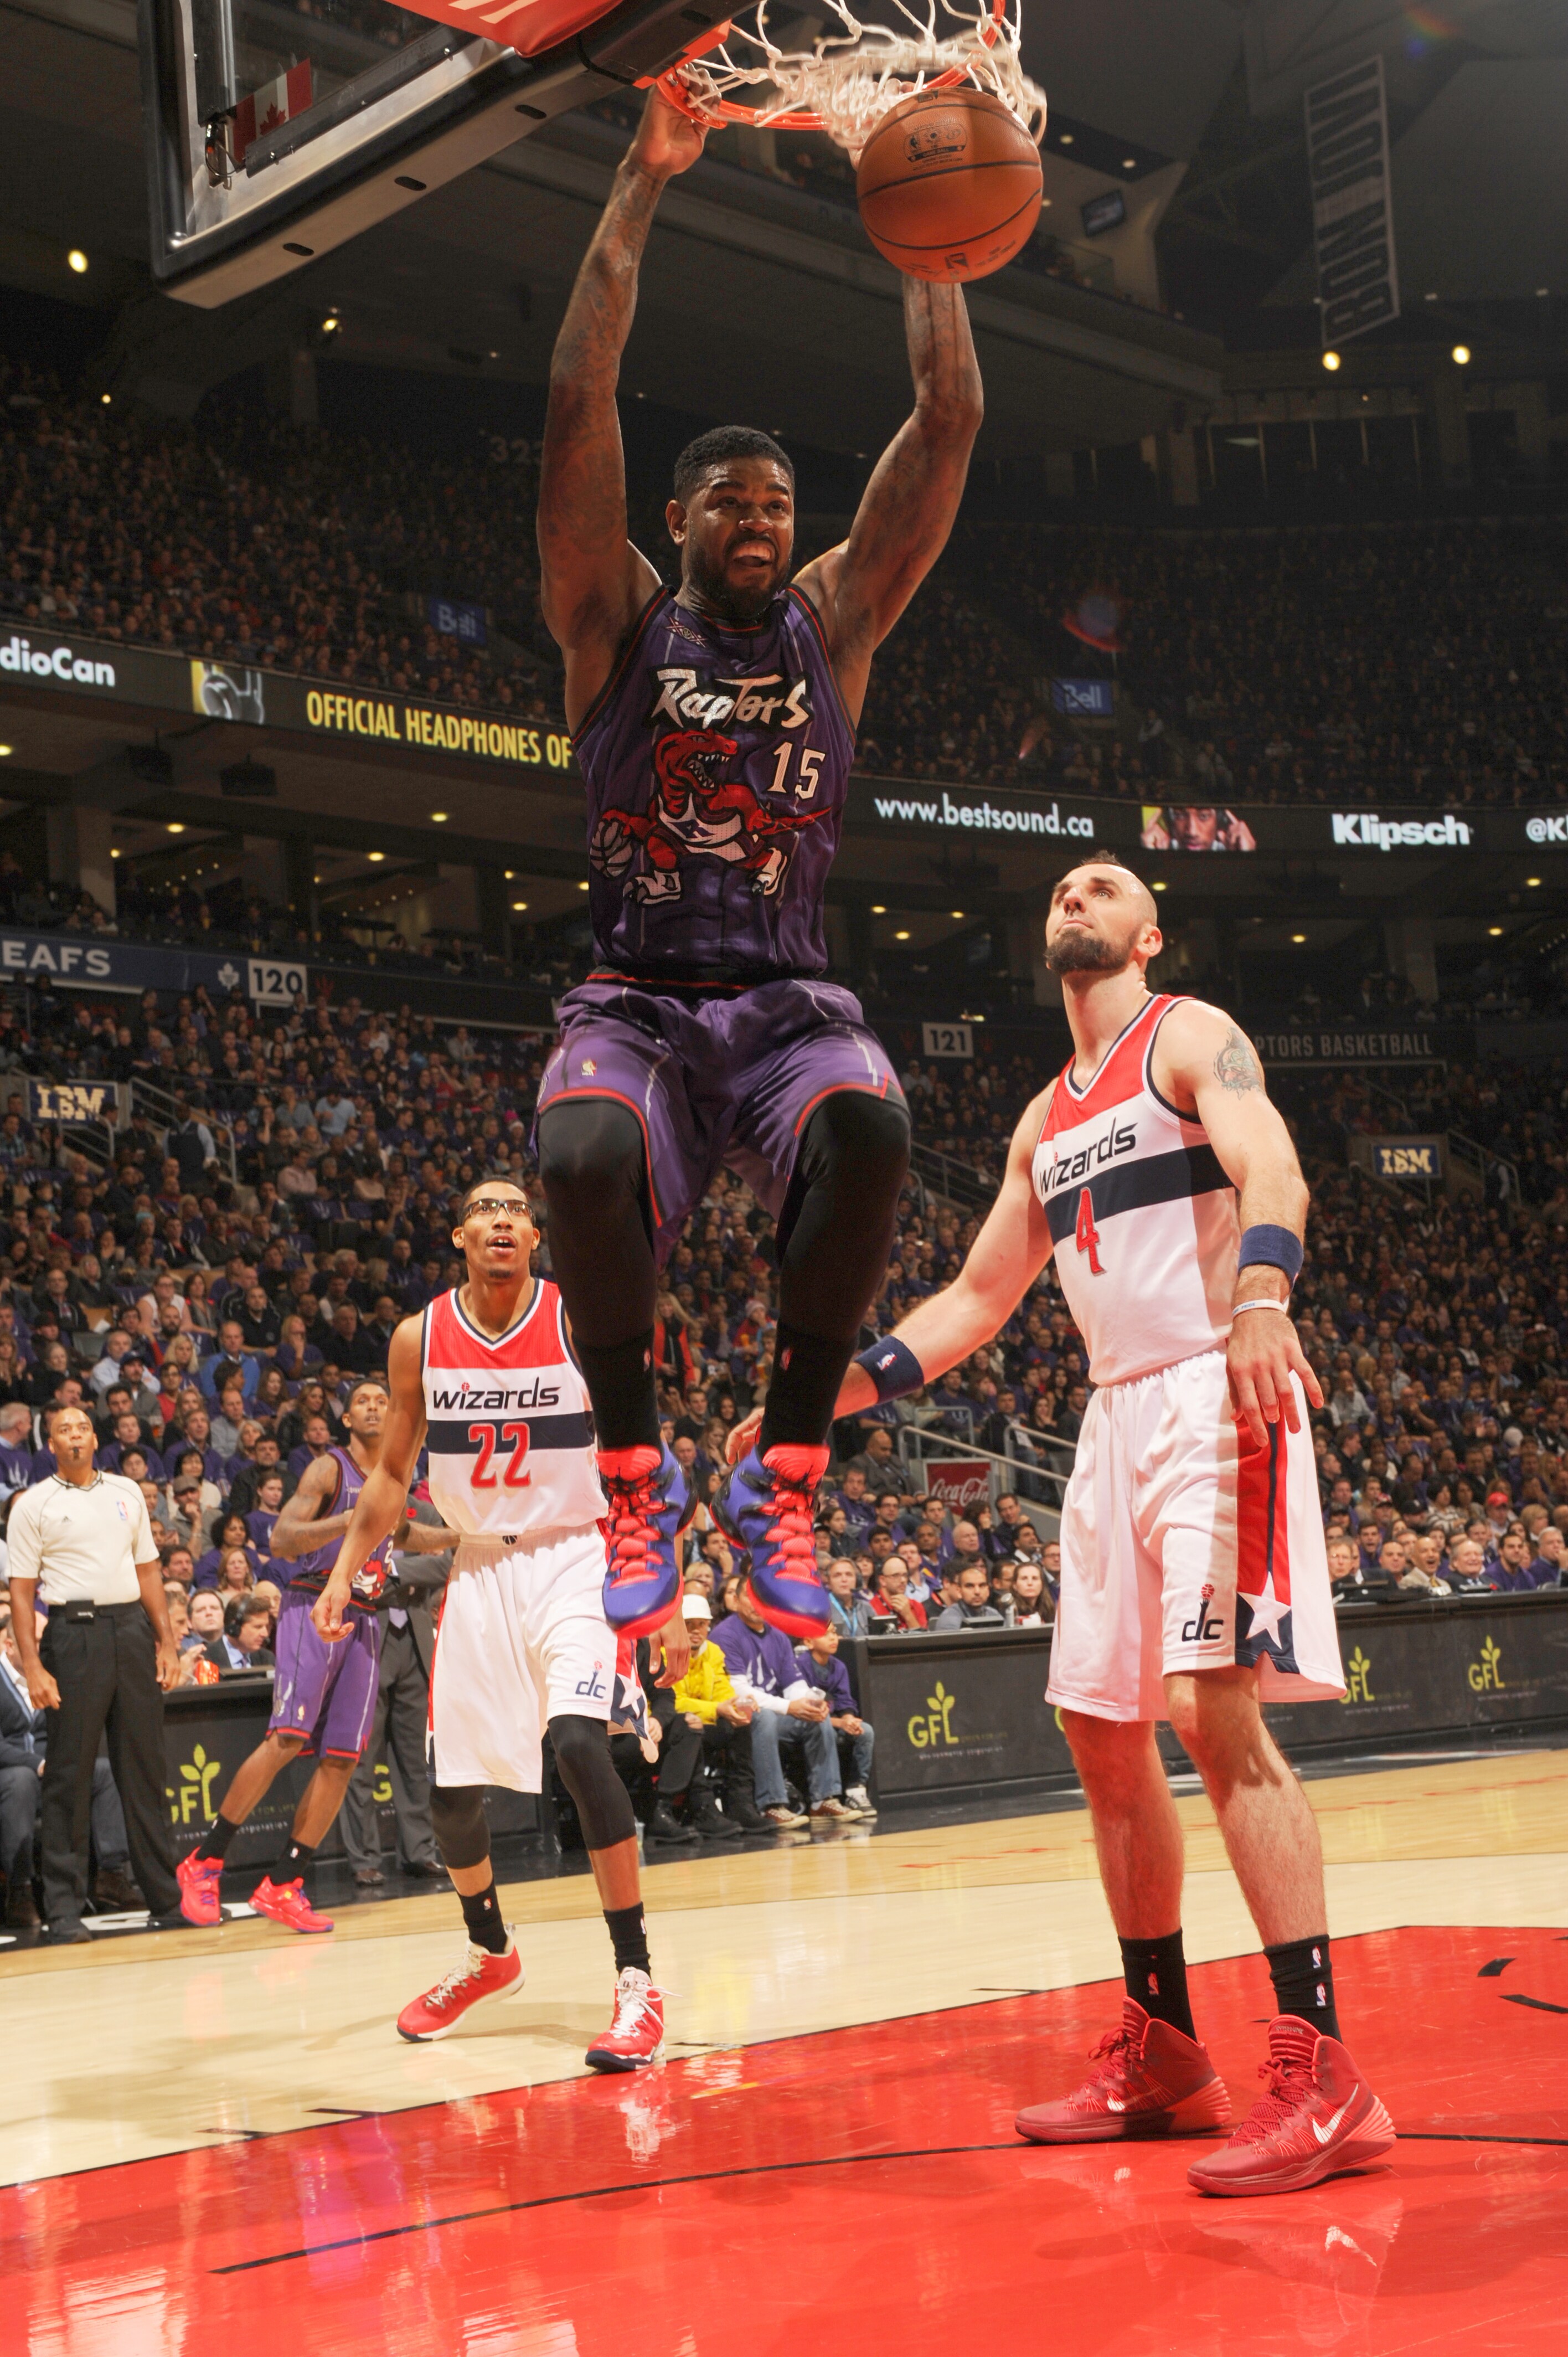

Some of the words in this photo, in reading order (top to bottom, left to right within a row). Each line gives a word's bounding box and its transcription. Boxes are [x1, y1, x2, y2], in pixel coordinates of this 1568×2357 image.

[306, 691, 400, 740] OFFICIAL
[405, 708, 541, 764] HEADPHONES
[546, 733, 572, 769] OF
[767, 741, 826, 800] 15
[874, 792, 1094, 838] www.bestsound.ca
[1331, 812, 1471, 851] Klipsch
[2, 942, 111, 976] EAFS
[253, 967, 303, 995] 120
[930, 1030, 966, 1051] 121
[1321, 1033, 1432, 1056] BASKETBALL
[37, 1083, 105, 1121] IBM
[1040, 1116, 1138, 1196] wizards
[1380, 1148, 1432, 1174] IBM
[1076, 1187, 1107, 1276] 4
[433, 1376, 562, 1411] wizards
[468, 1422, 532, 1489] 22
[1182, 1599, 1224, 1643] dc
[575, 1670, 606, 1699] dc
[1469, 1648, 1505, 1692] GFL
[907, 1695, 960, 1748] GFL
